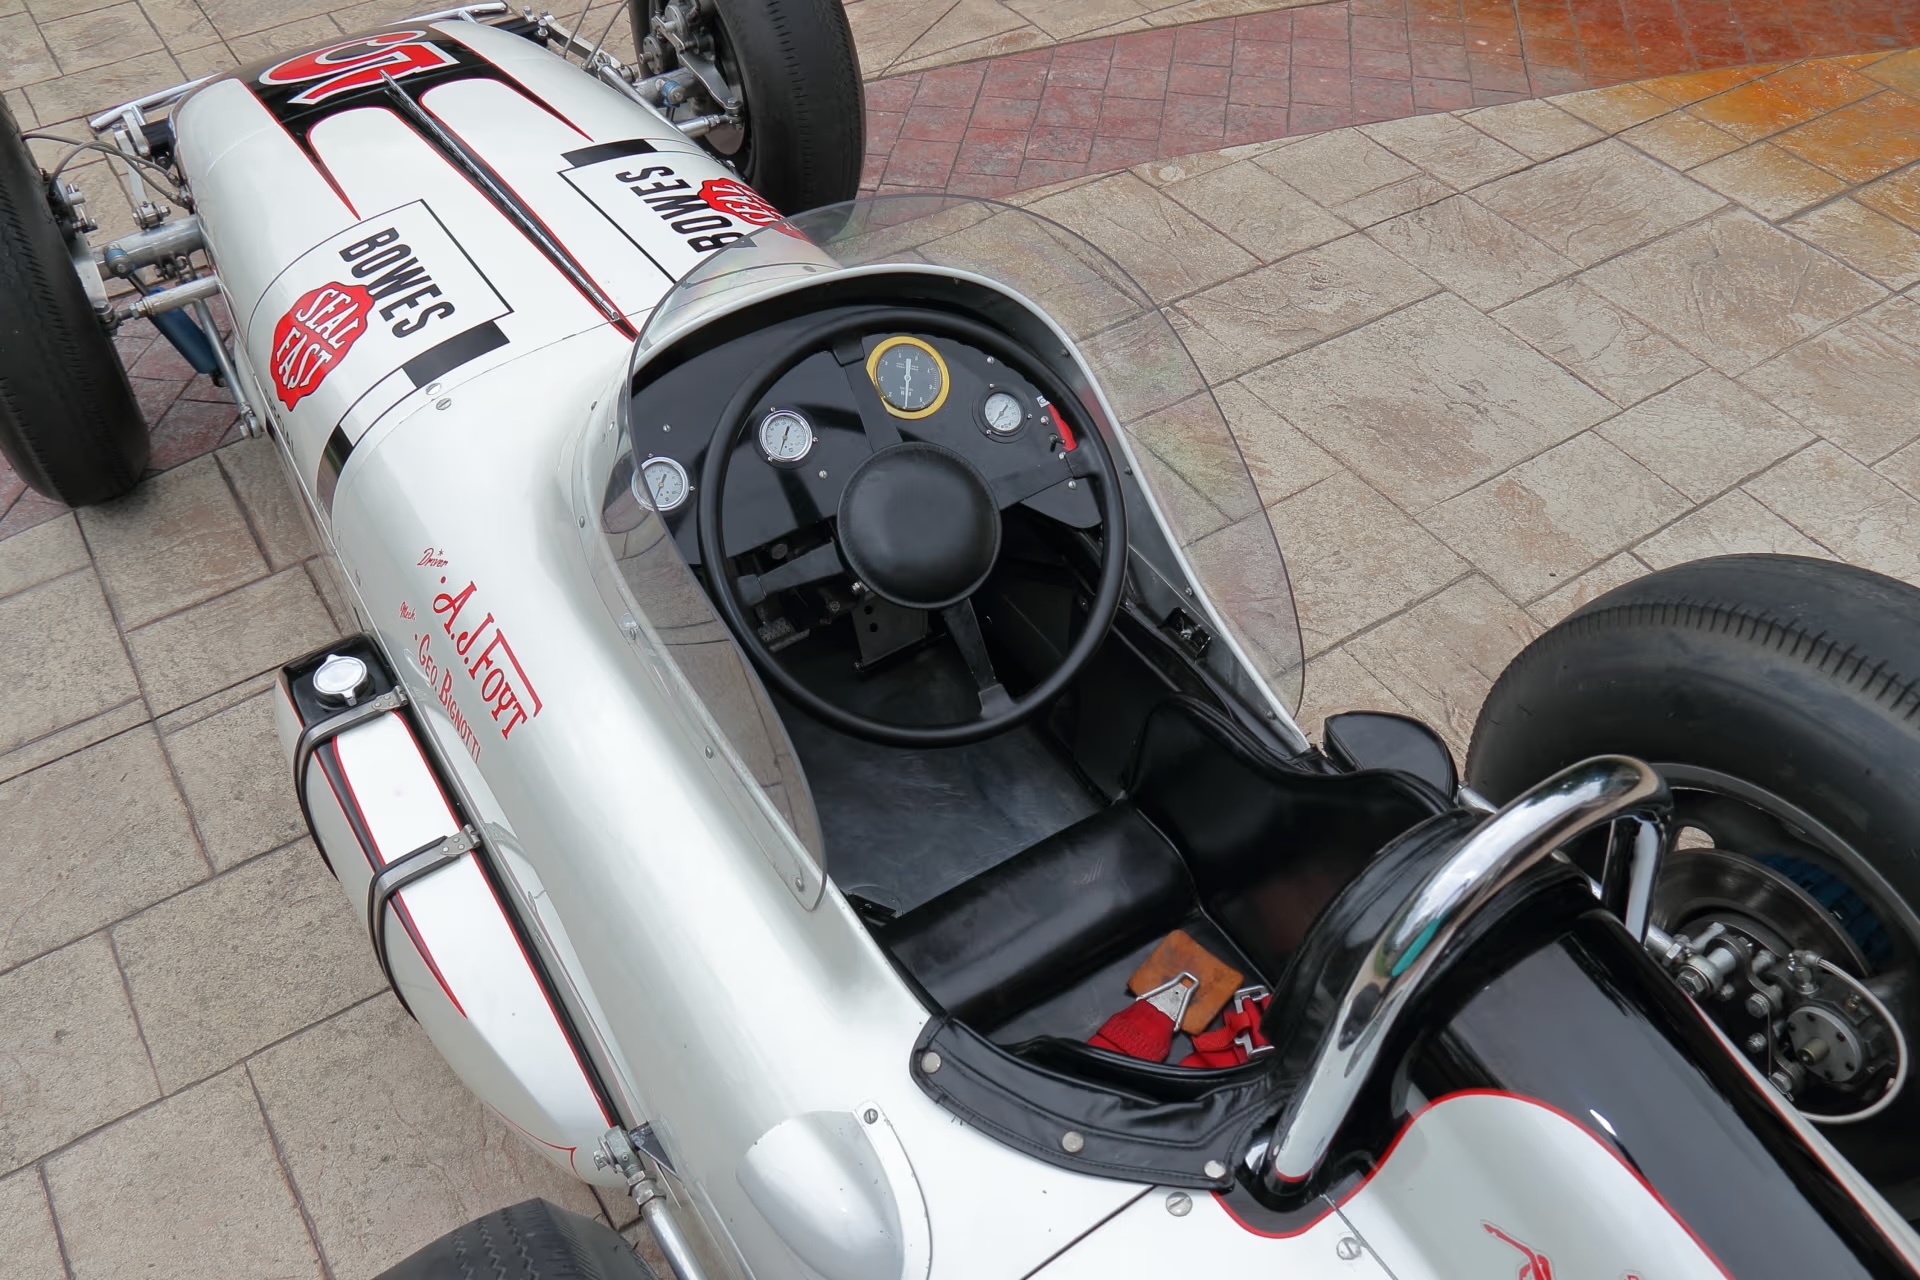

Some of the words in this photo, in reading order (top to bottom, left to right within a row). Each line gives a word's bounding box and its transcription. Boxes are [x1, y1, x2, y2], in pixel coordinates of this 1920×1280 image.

[615, 165, 744, 252] BOWES
[338, 227, 456, 338] BOWES
[295, 288, 360, 350] SEAL
[276, 327, 332, 389] FAST
[416, 547, 448, 567] Driver
